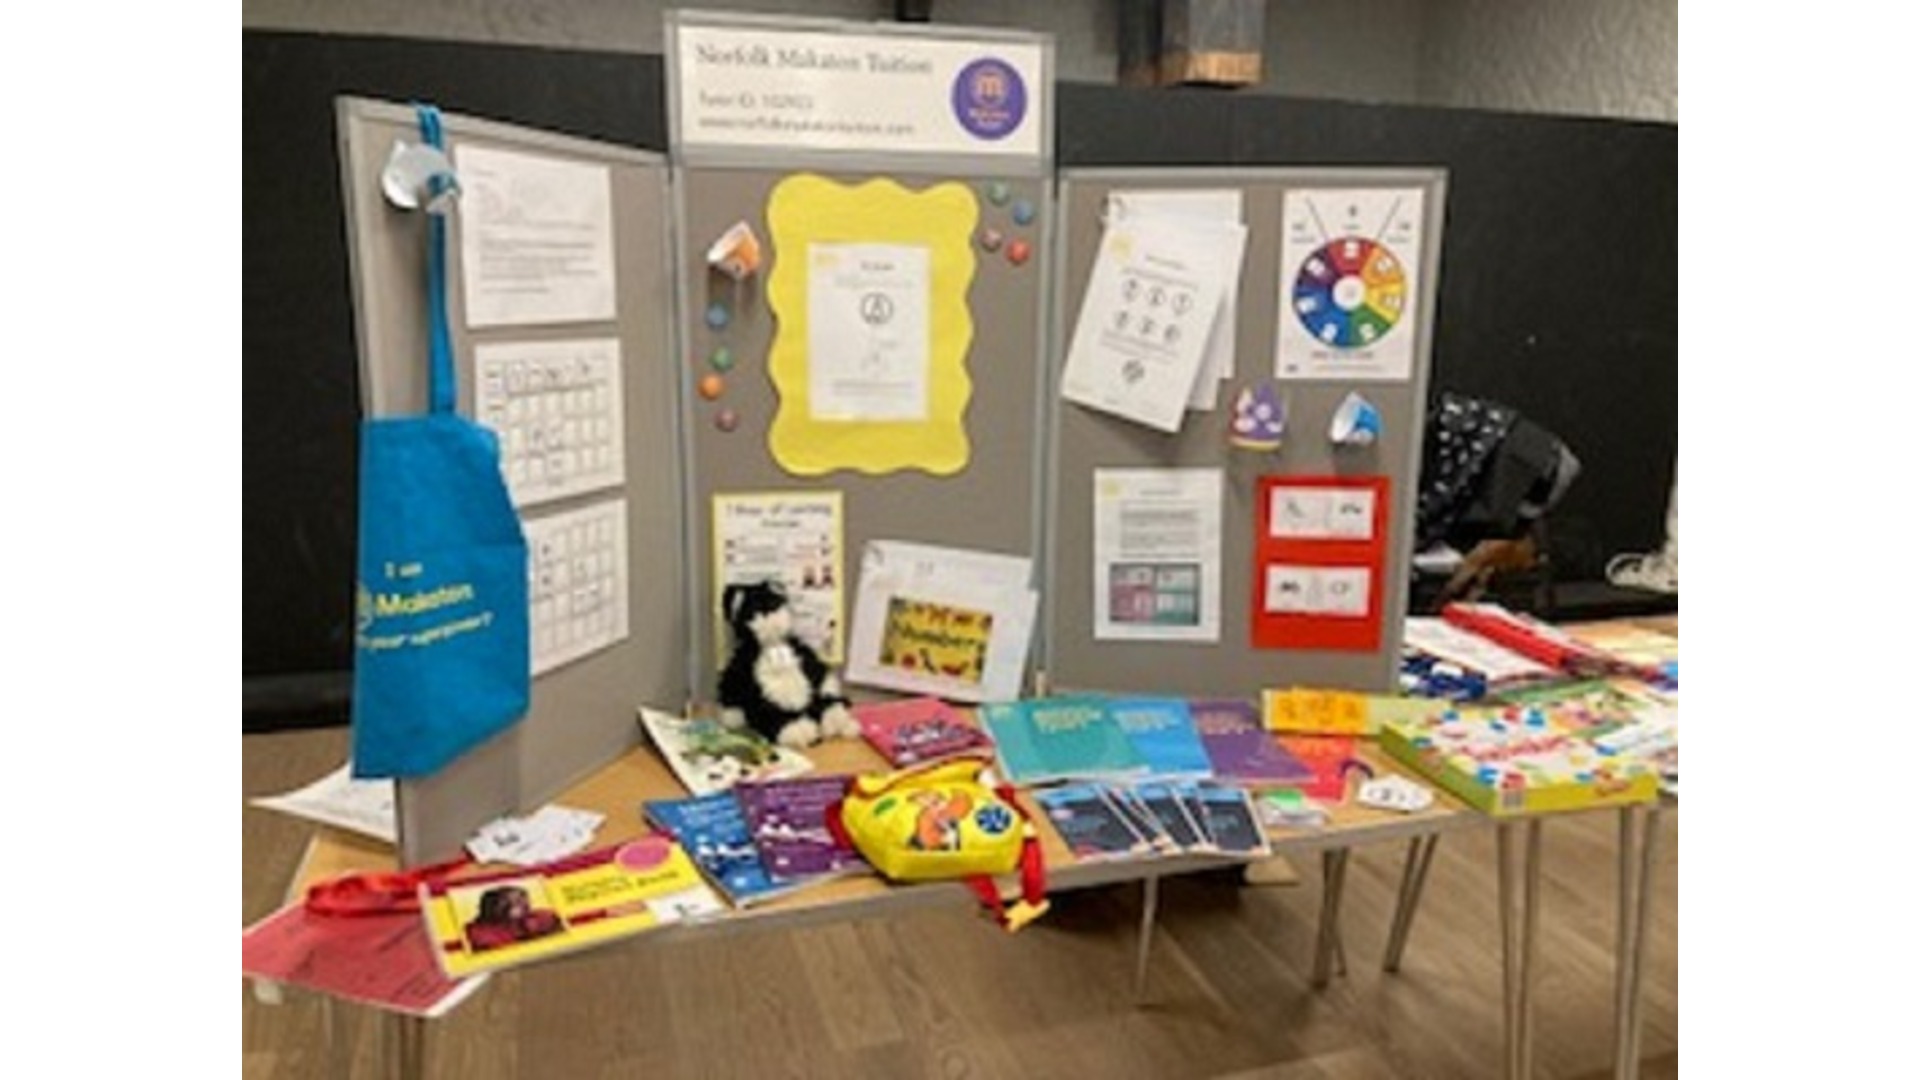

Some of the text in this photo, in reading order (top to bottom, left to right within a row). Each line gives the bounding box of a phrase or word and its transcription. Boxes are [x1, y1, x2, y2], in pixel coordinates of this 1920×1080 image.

[696, 43, 933, 74] Norfolk Makaton Tuition
[384, 561, 395, 579] I
[374, 583, 475, 617] Makaton
